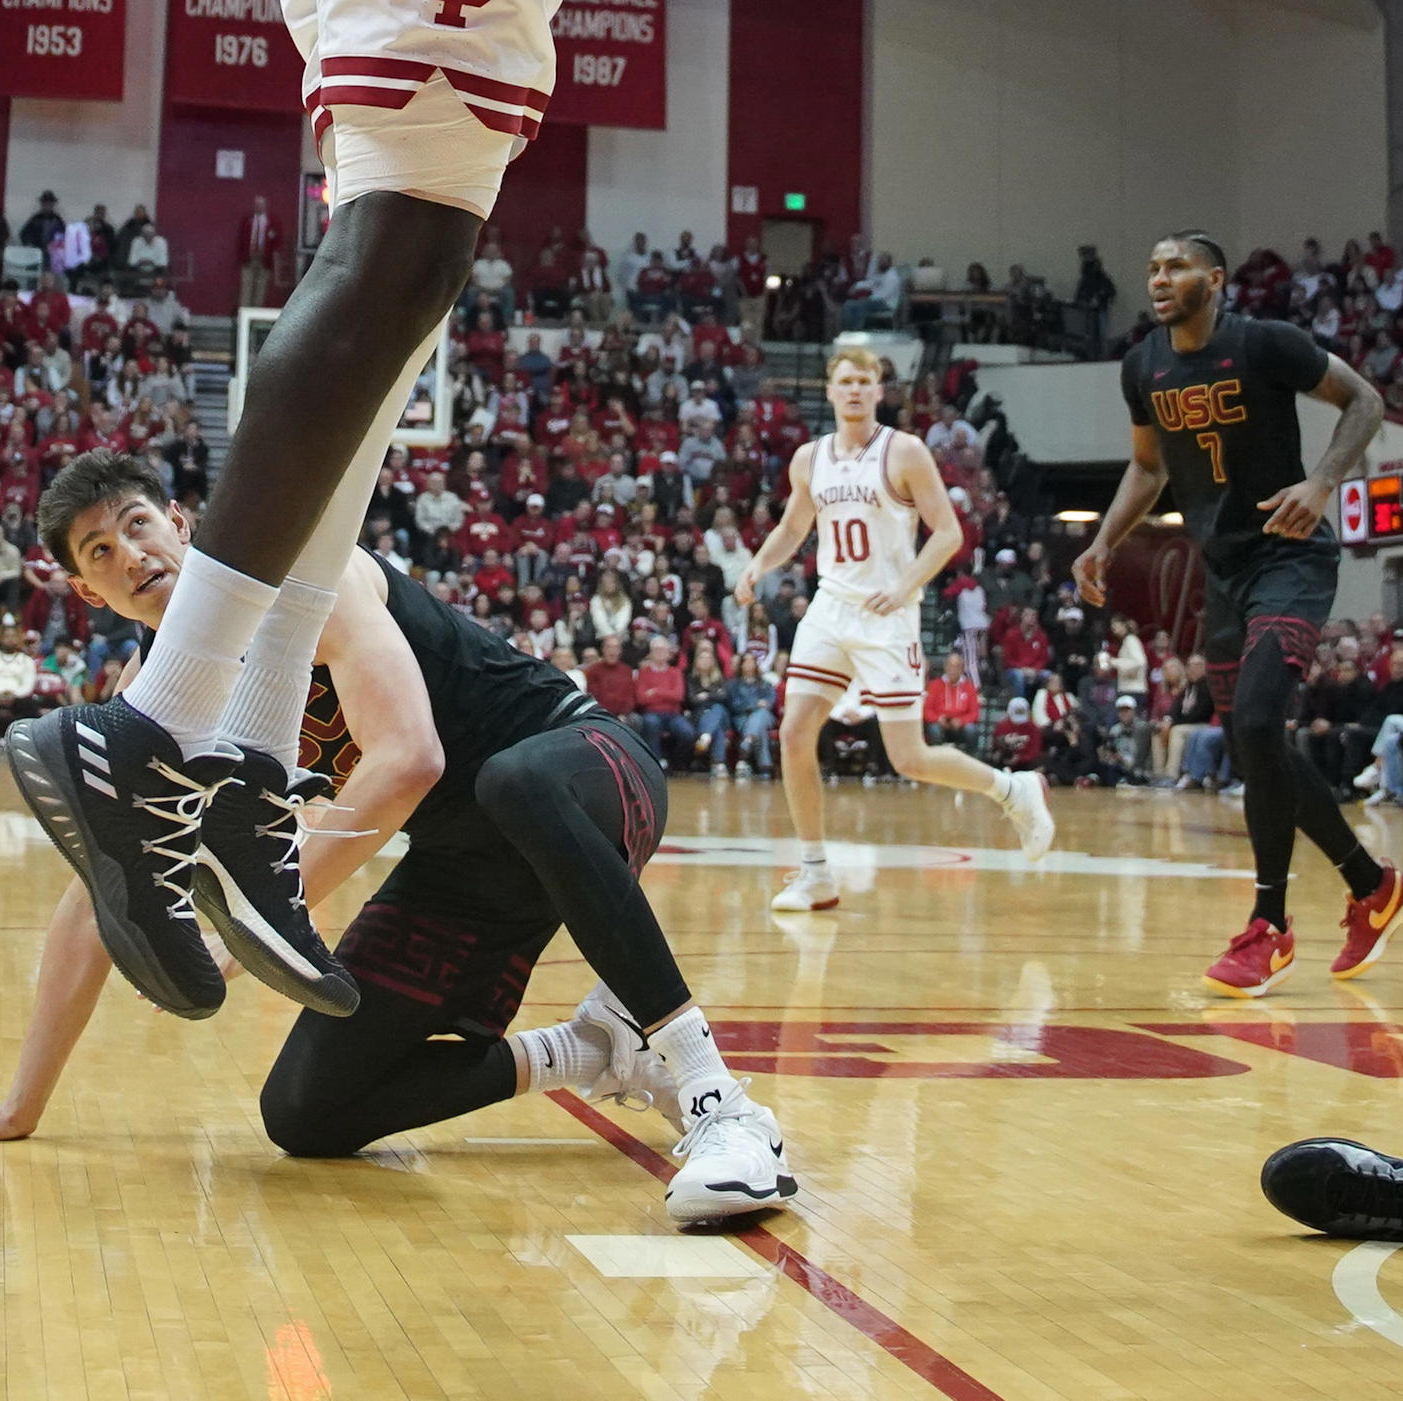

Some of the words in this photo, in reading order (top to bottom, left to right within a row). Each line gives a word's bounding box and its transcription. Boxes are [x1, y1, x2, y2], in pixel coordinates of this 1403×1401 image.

[26, 23, 83, 57] 1953
[214, 33, 269, 67] 1976
[572, 53, 627, 88] 1987
[1150, 378, 1249, 432] USC
[1196, 431, 1227, 484] 7
[832, 518, 871, 564] 10
